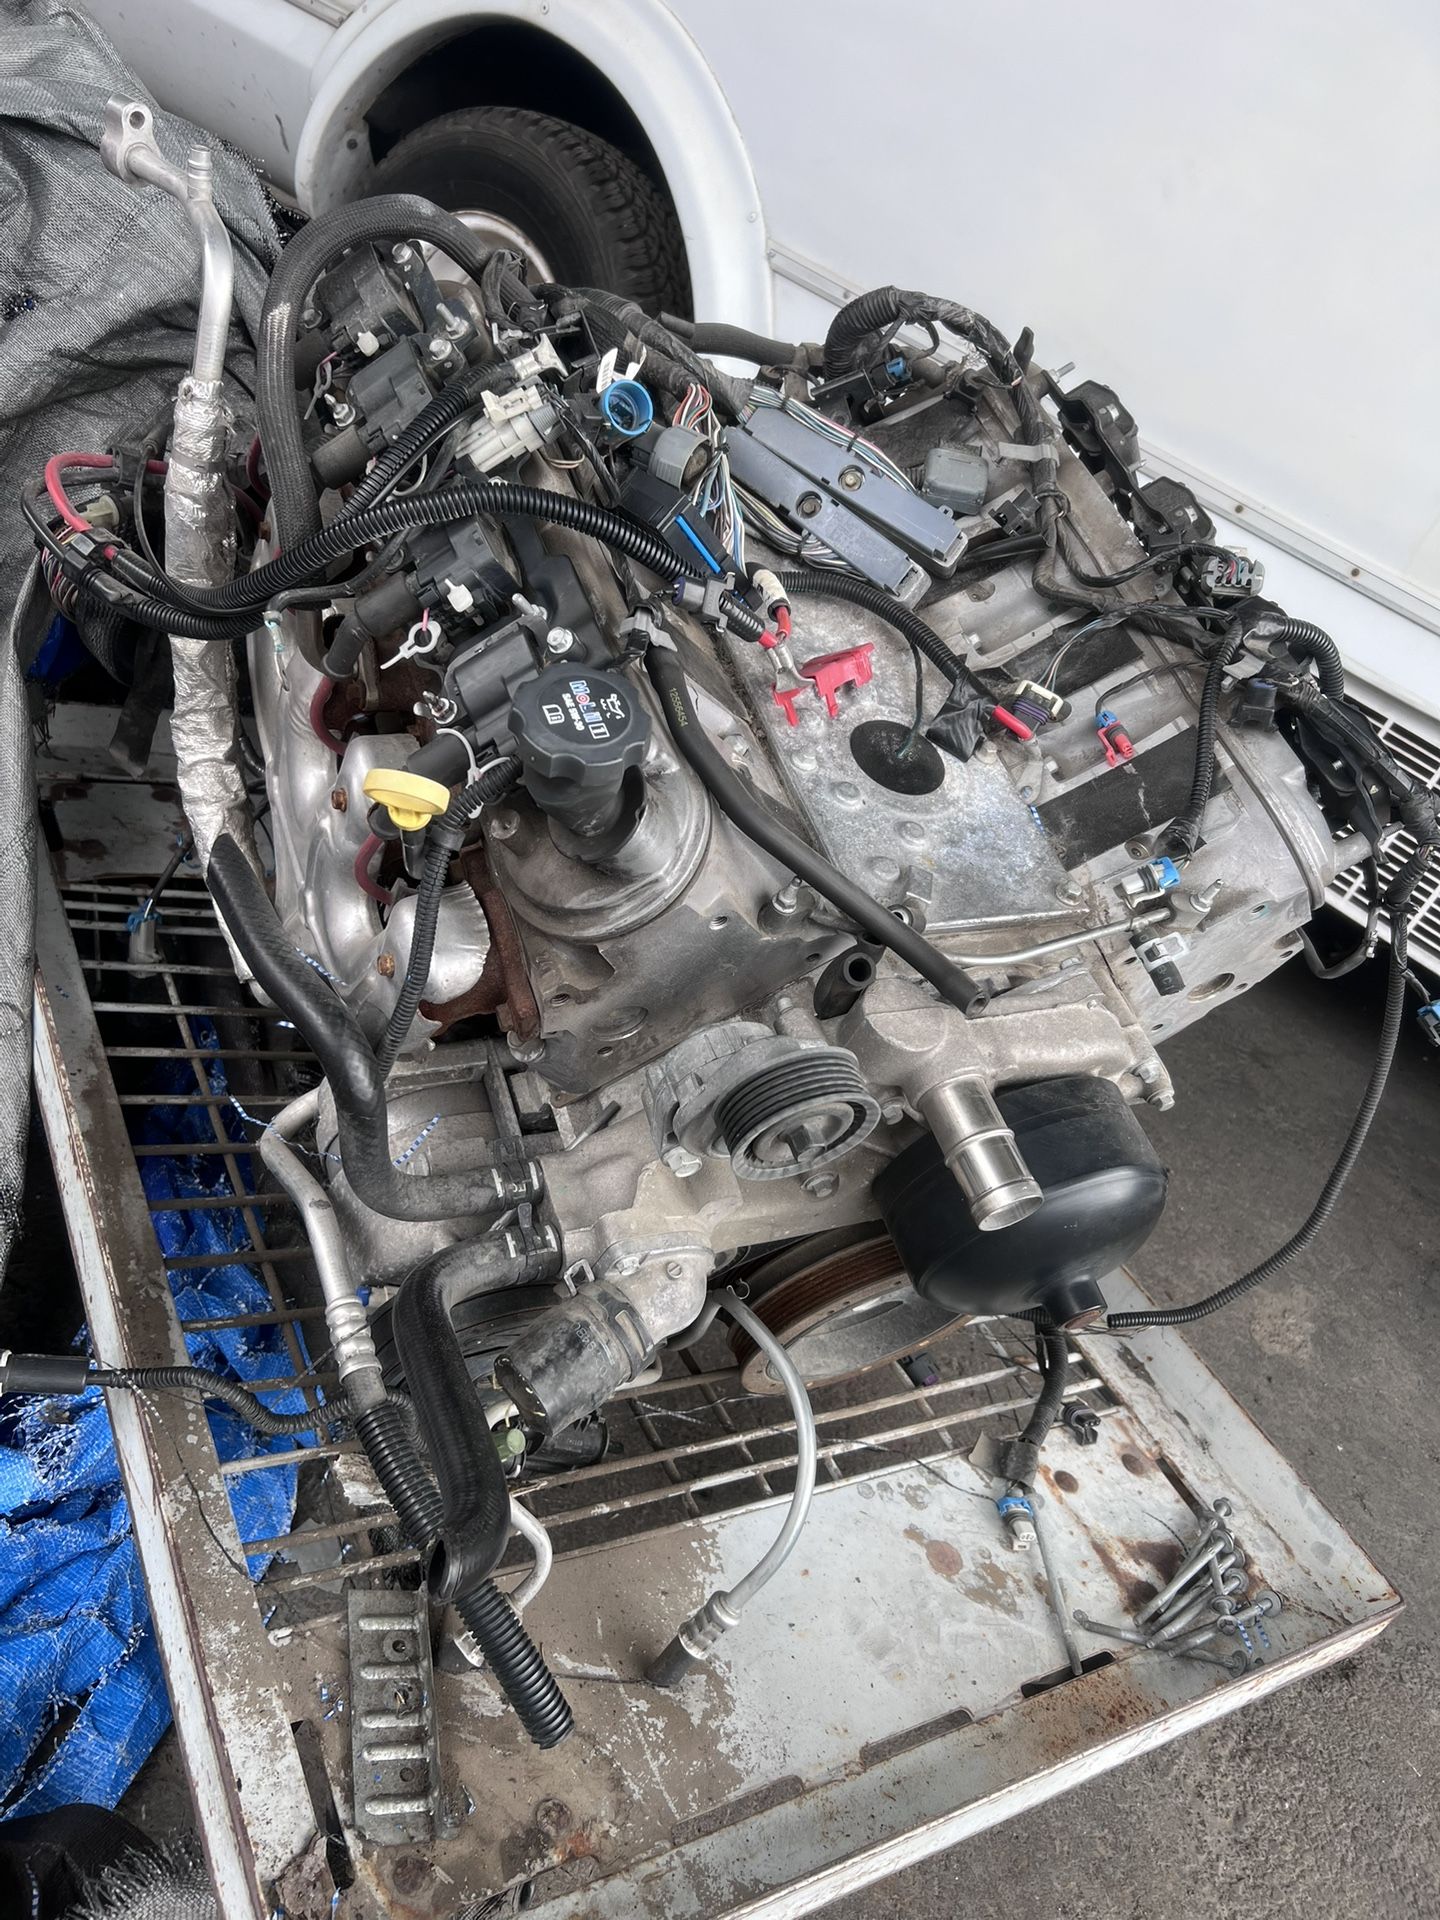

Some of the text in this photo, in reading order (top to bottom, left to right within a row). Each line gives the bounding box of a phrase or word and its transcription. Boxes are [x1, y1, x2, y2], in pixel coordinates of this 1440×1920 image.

[562, 692, 585, 731] SAE 5W-30
[669, 687, 689, 728] 12556454
[588, 723, 610, 739] 1
